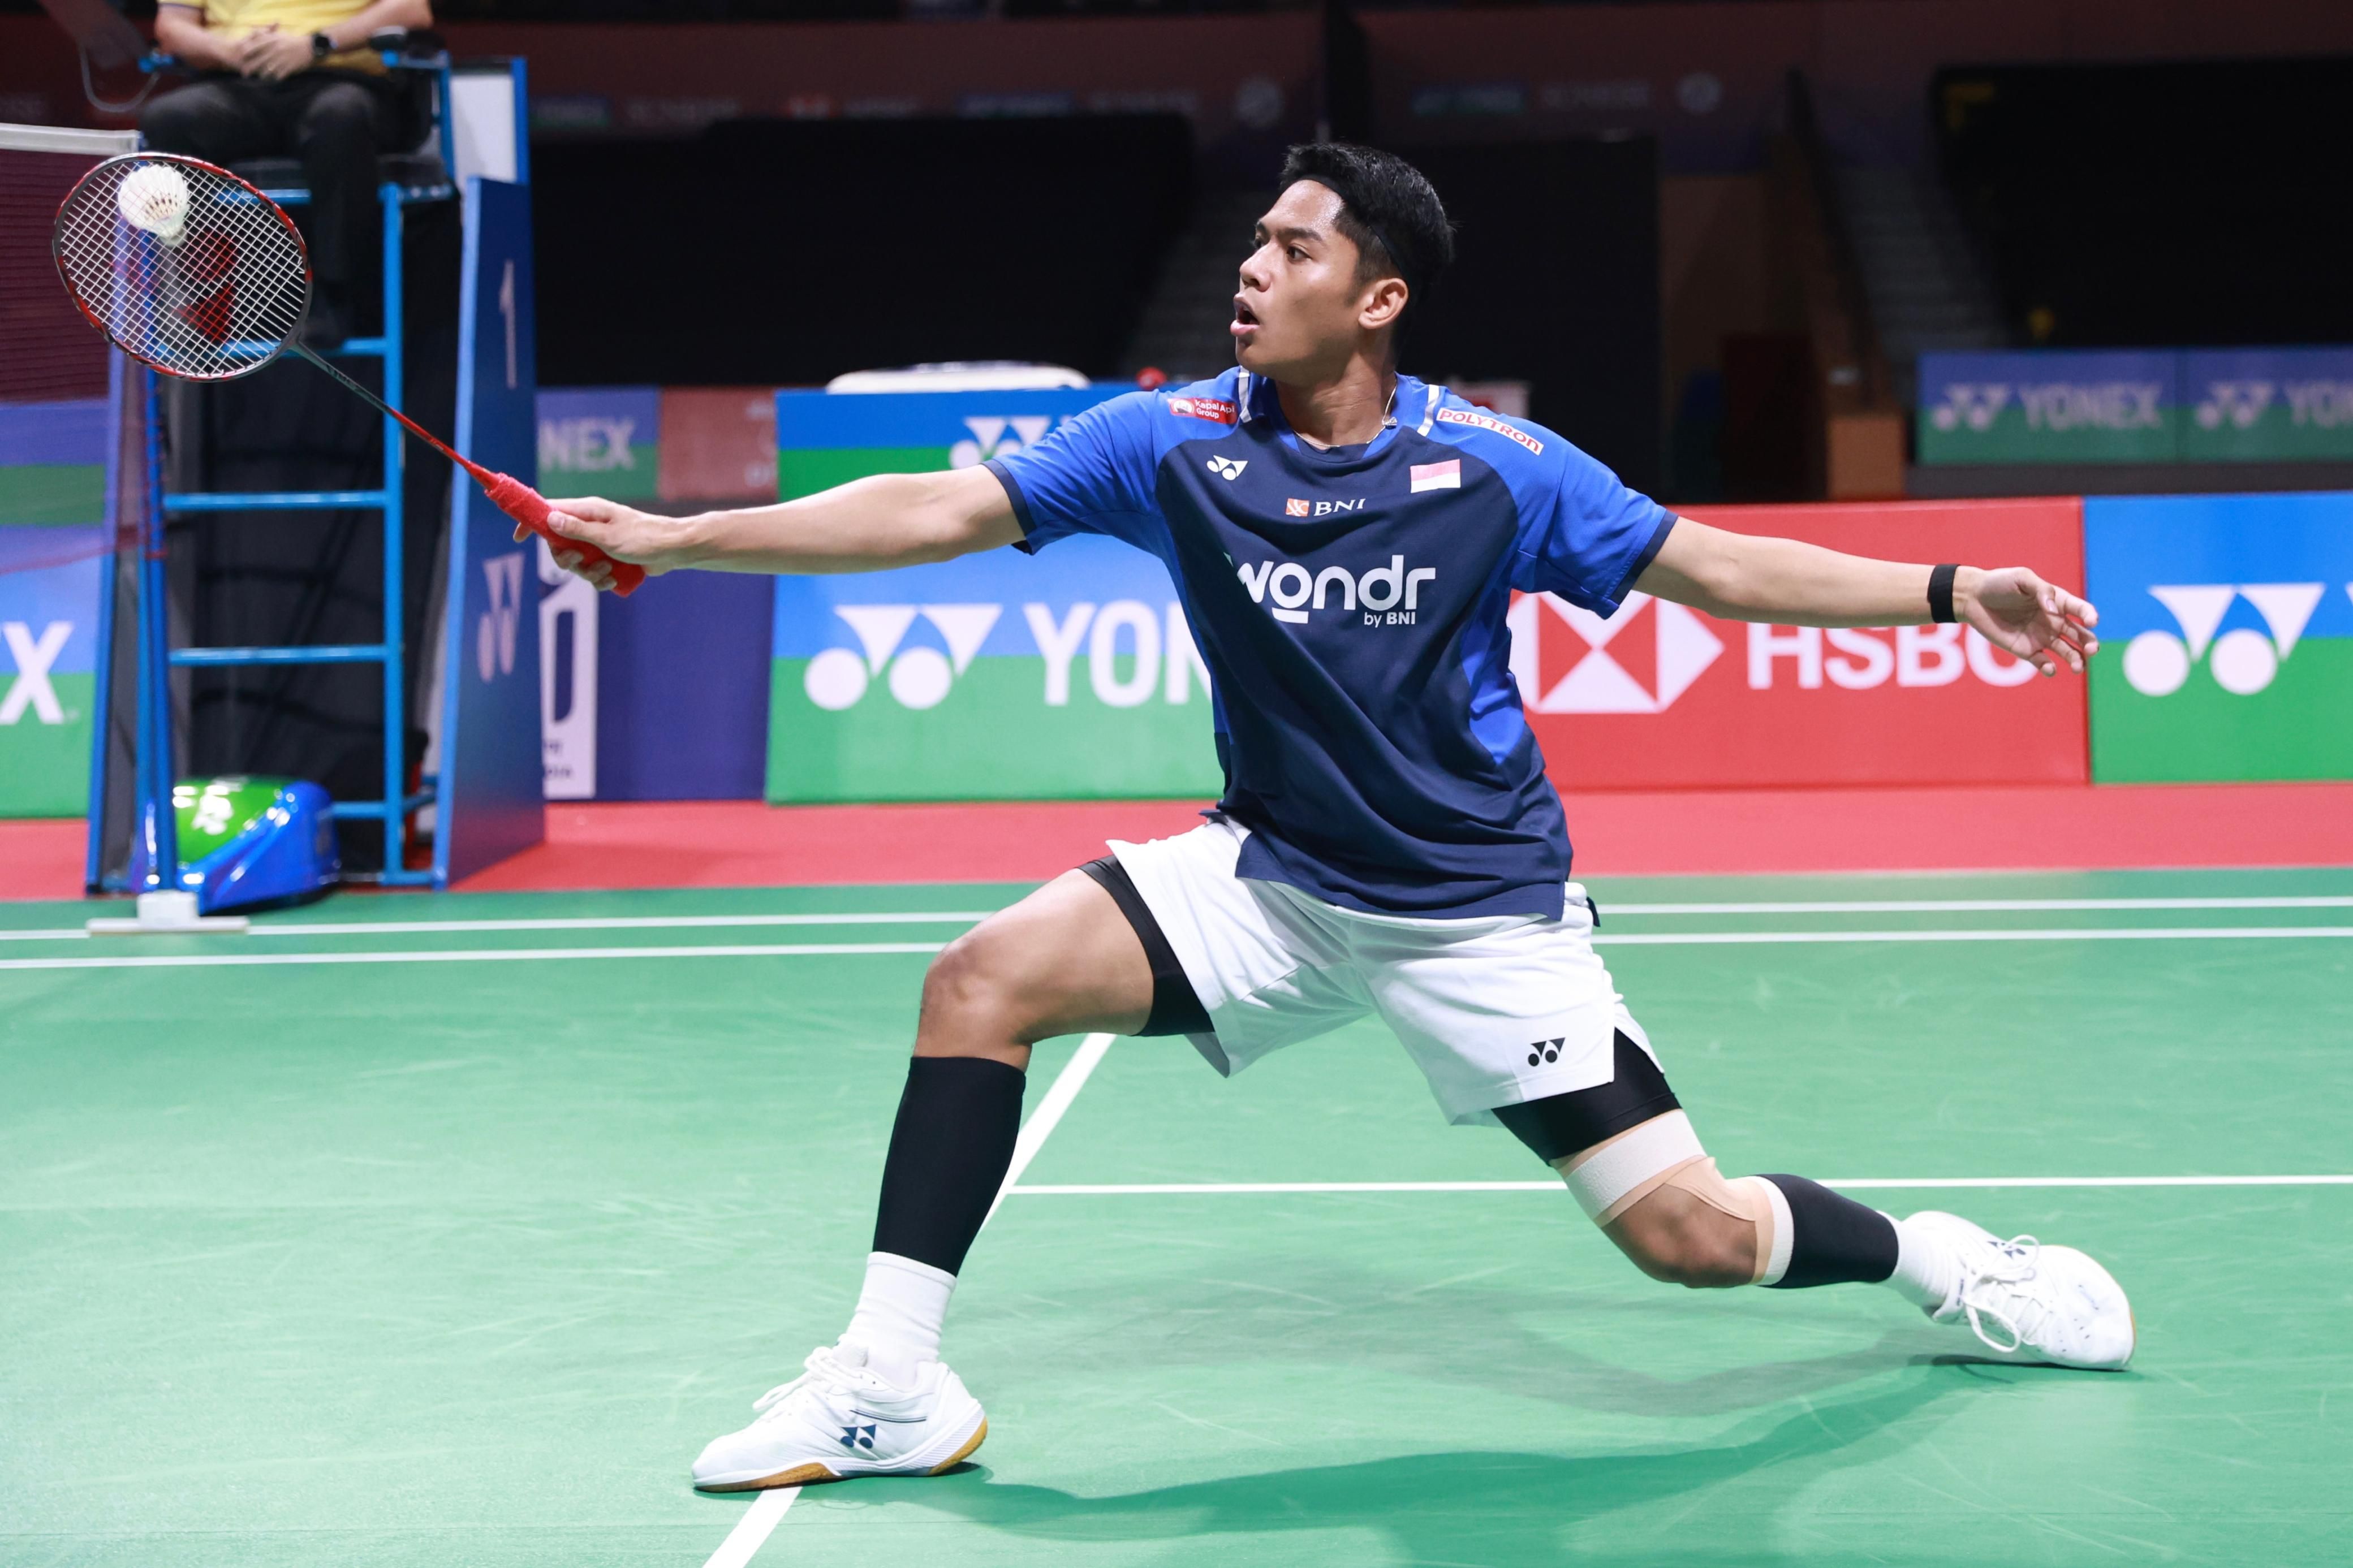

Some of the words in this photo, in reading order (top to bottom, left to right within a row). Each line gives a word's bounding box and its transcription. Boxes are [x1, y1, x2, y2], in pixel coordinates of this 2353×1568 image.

[1195, 399, 1219, 411] Kapal
[1219, 404, 1235, 414] Api
[1196, 408, 1219, 419] Group
[2019, 382, 2162, 430] YONEX
[1313, 498, 1366, 516] BNI
[1364, 612, 1381, 628] by
[1386, 612, 1416, 625] BNI
